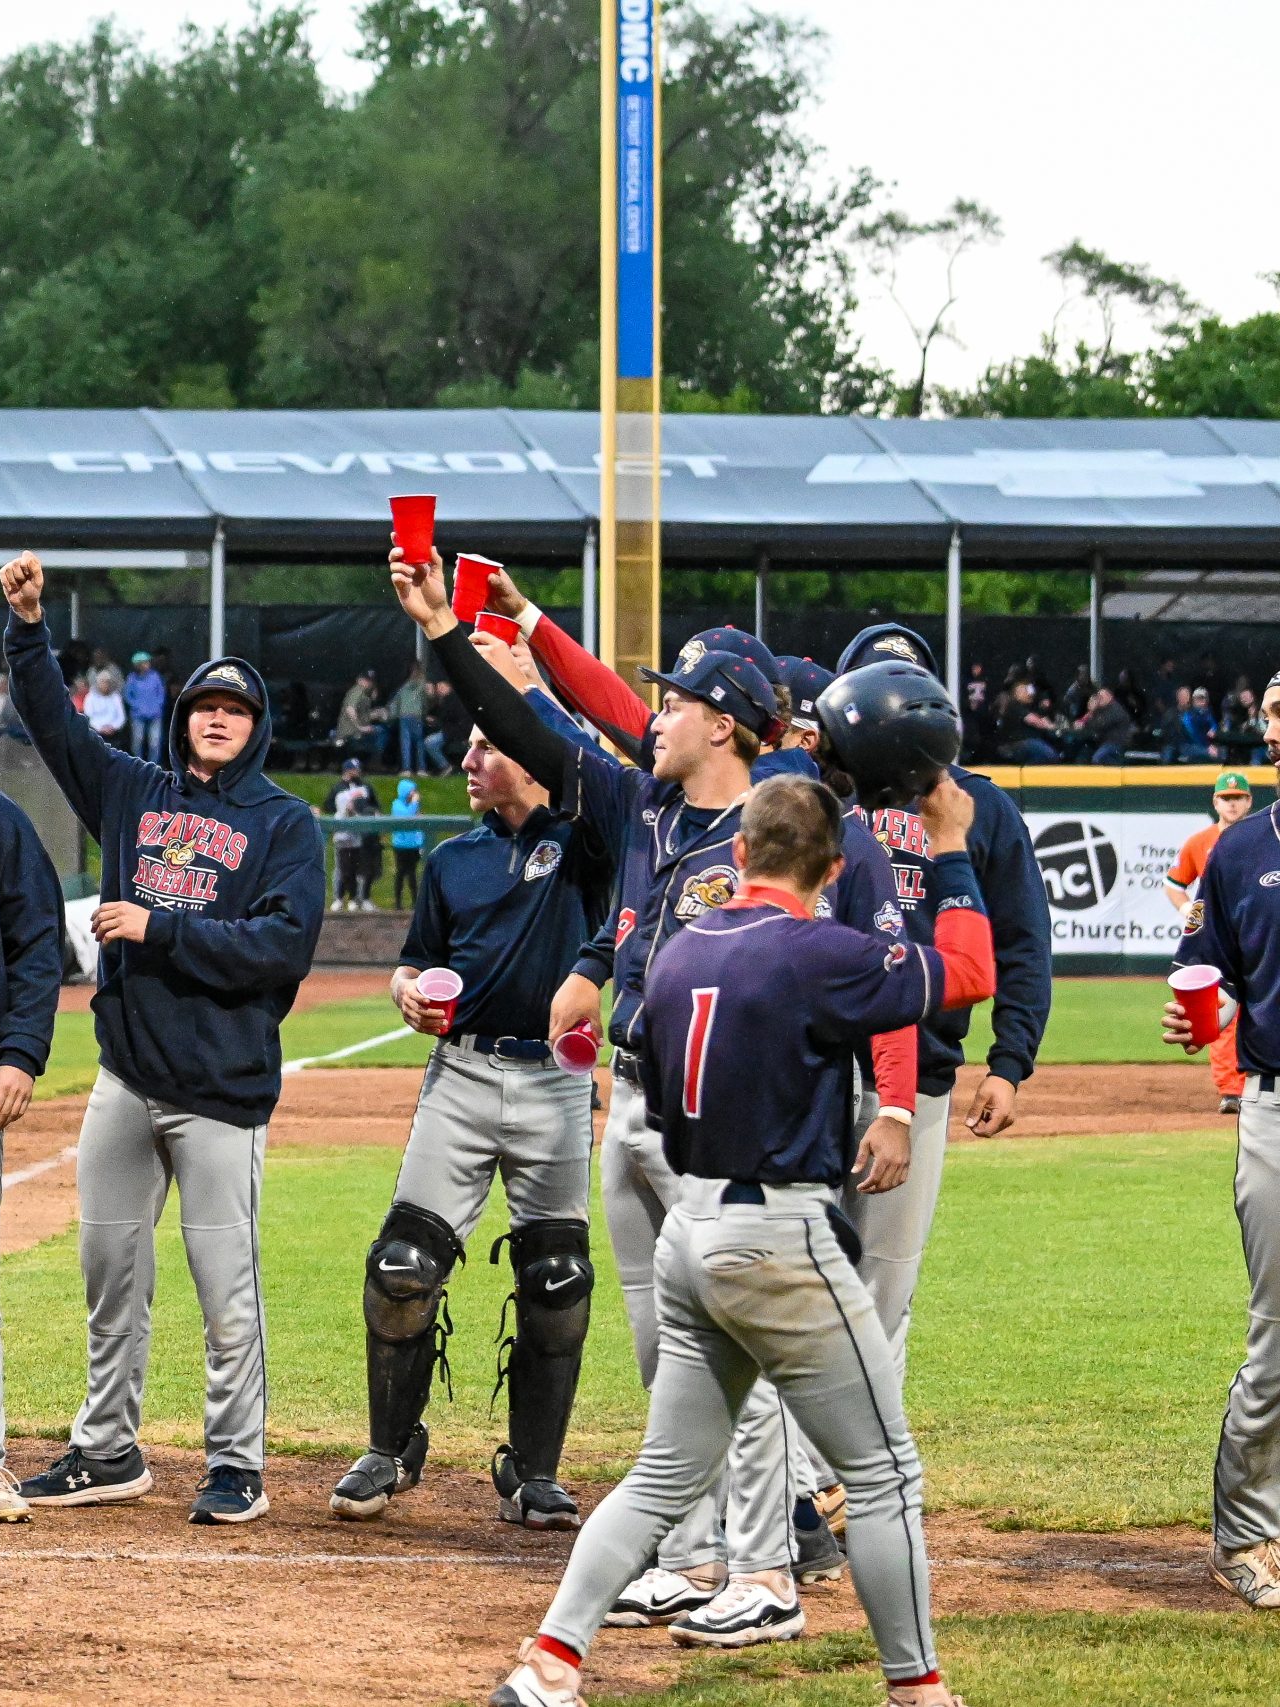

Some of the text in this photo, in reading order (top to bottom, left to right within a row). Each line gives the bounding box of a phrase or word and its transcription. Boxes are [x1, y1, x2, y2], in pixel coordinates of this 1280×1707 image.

[48, 449, 728, 479] CHEVROLET
[136, 808, 248, 871] BEAVERS
[1138, 845, 1179, 859] Thre
[1124, 861, 1169, 875] Locat
[1141, 876, 1164, 890] On
[1052, 919, 1181, 940] Church.co
[682, 987, 719, 1118] 1
